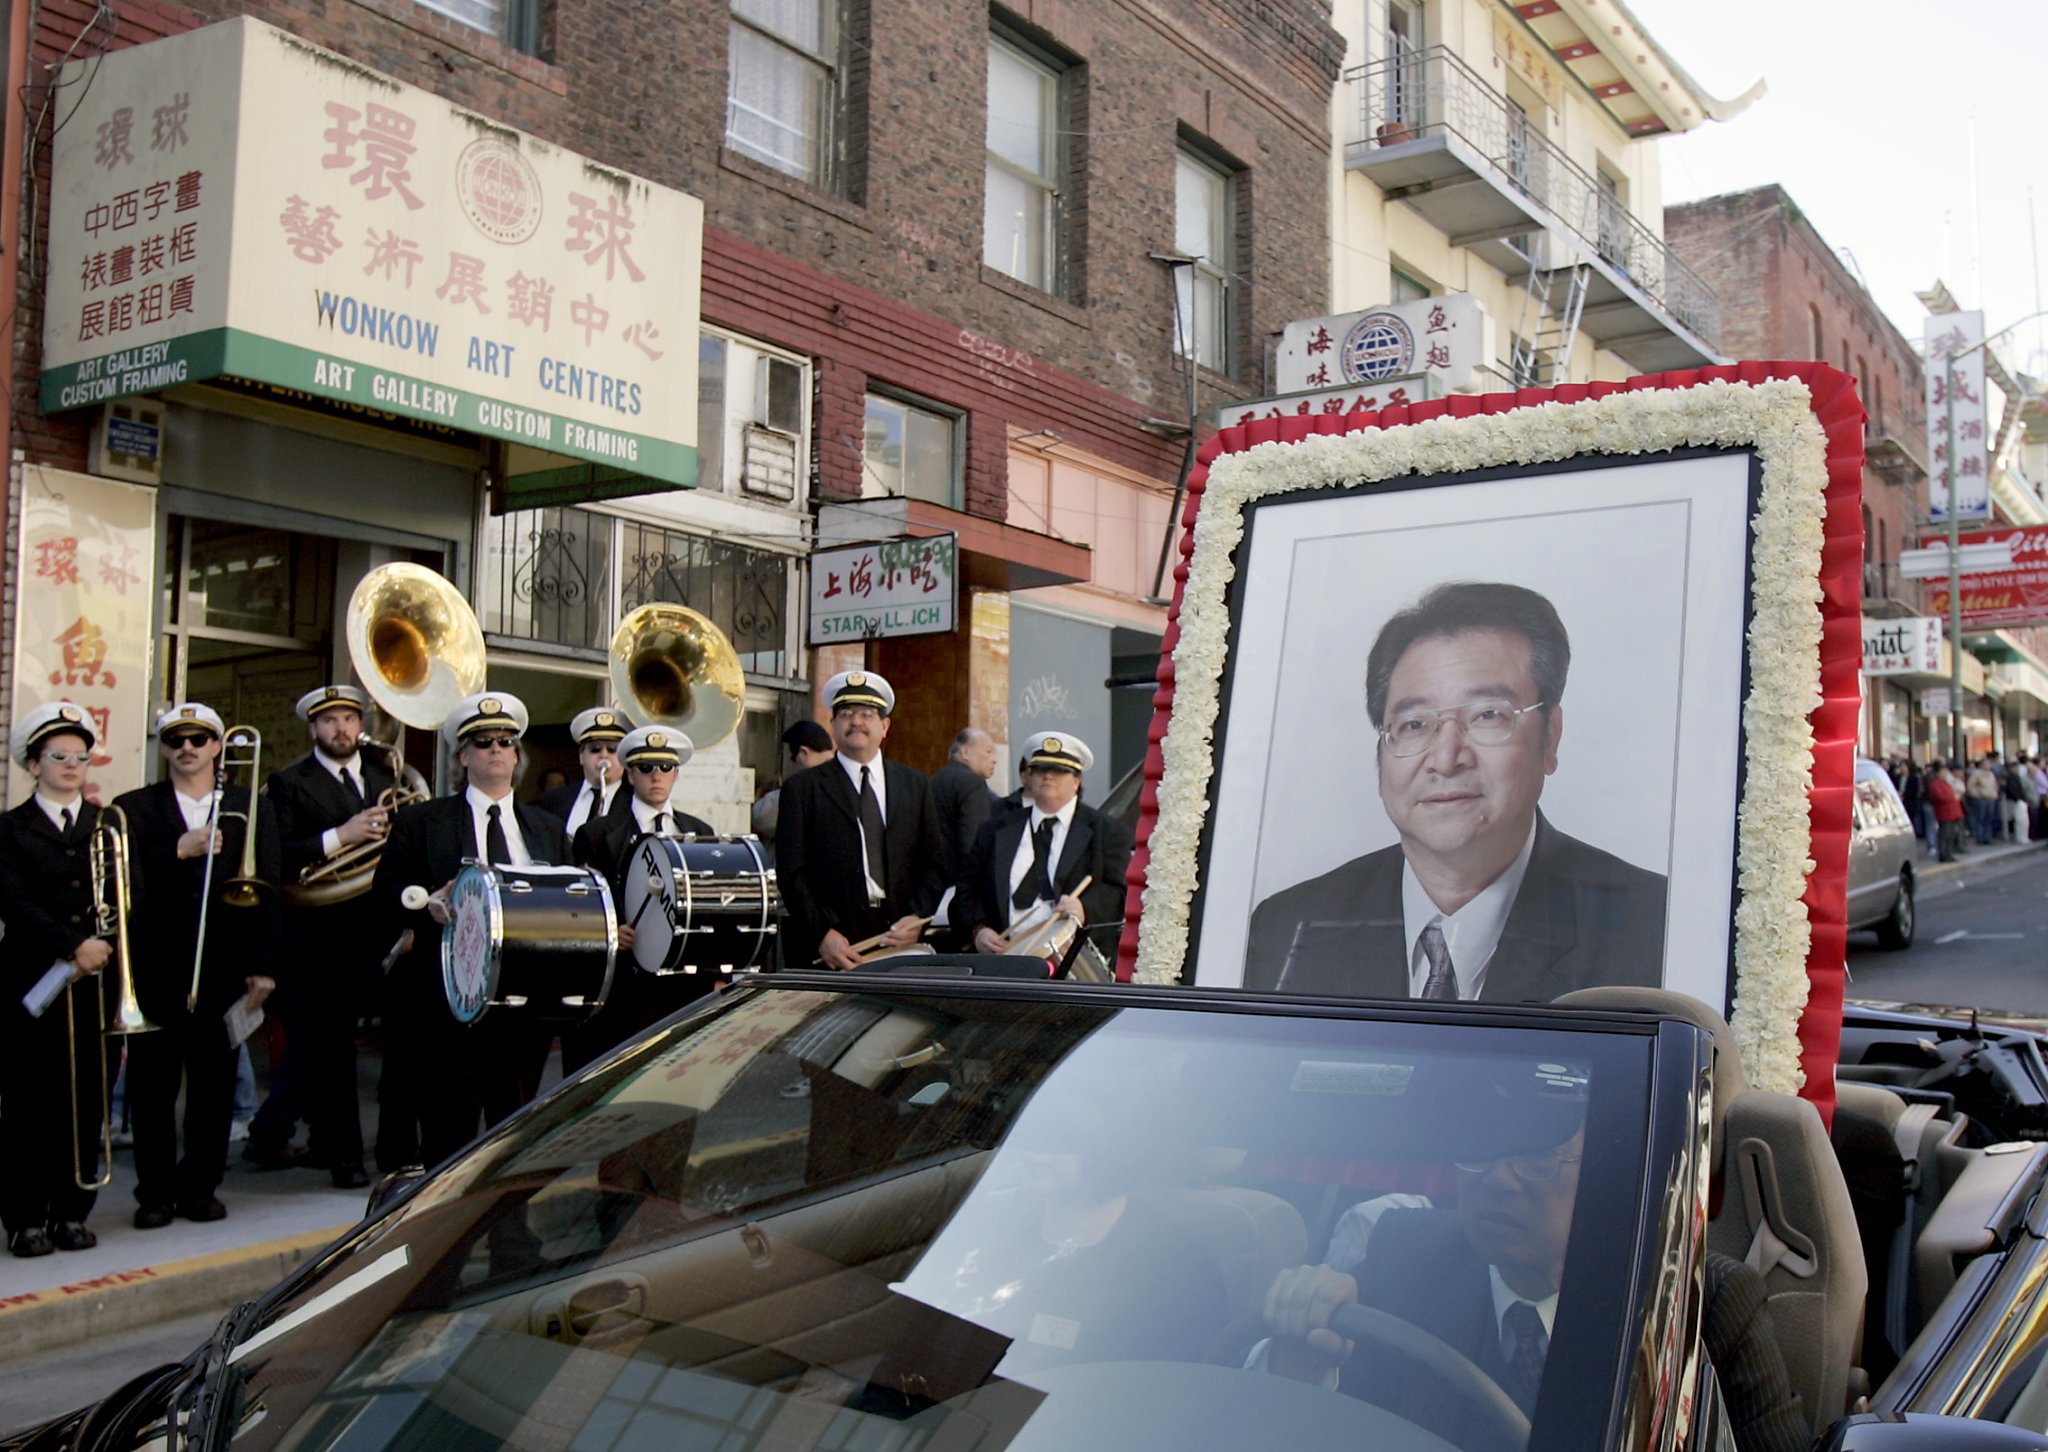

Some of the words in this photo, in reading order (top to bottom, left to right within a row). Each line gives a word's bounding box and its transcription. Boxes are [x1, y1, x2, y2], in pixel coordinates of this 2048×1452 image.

[84, 170, 203, 239] 中西字畫
[81, 221, 198, 292] 裱畫裝框
[280, 194, 665, 361] 藝術展銷中心
[78, 274, 196, 343] 展館租賃
[61, 377, 117, 407] CUSTOM
[122, 359, 188, 394] FRAMING
[77, 358, 104, 382] ART
[106, 341, 171, 375] GALLERY
[315, 288, 439, 358] WONKOW
[467, 336, 515, 379] ART
[539, 356, 643, 416] CENTRES
[1307, 324, 1334, 389] 海味
[314, 359, 355, 391] ART
[372, 374, 458, 417] GALLERY
[478, 401, 551, 440] CUSTOM
[564, 422, 638, 461] FRAMING
[822, 614, 864, 635] STAR
